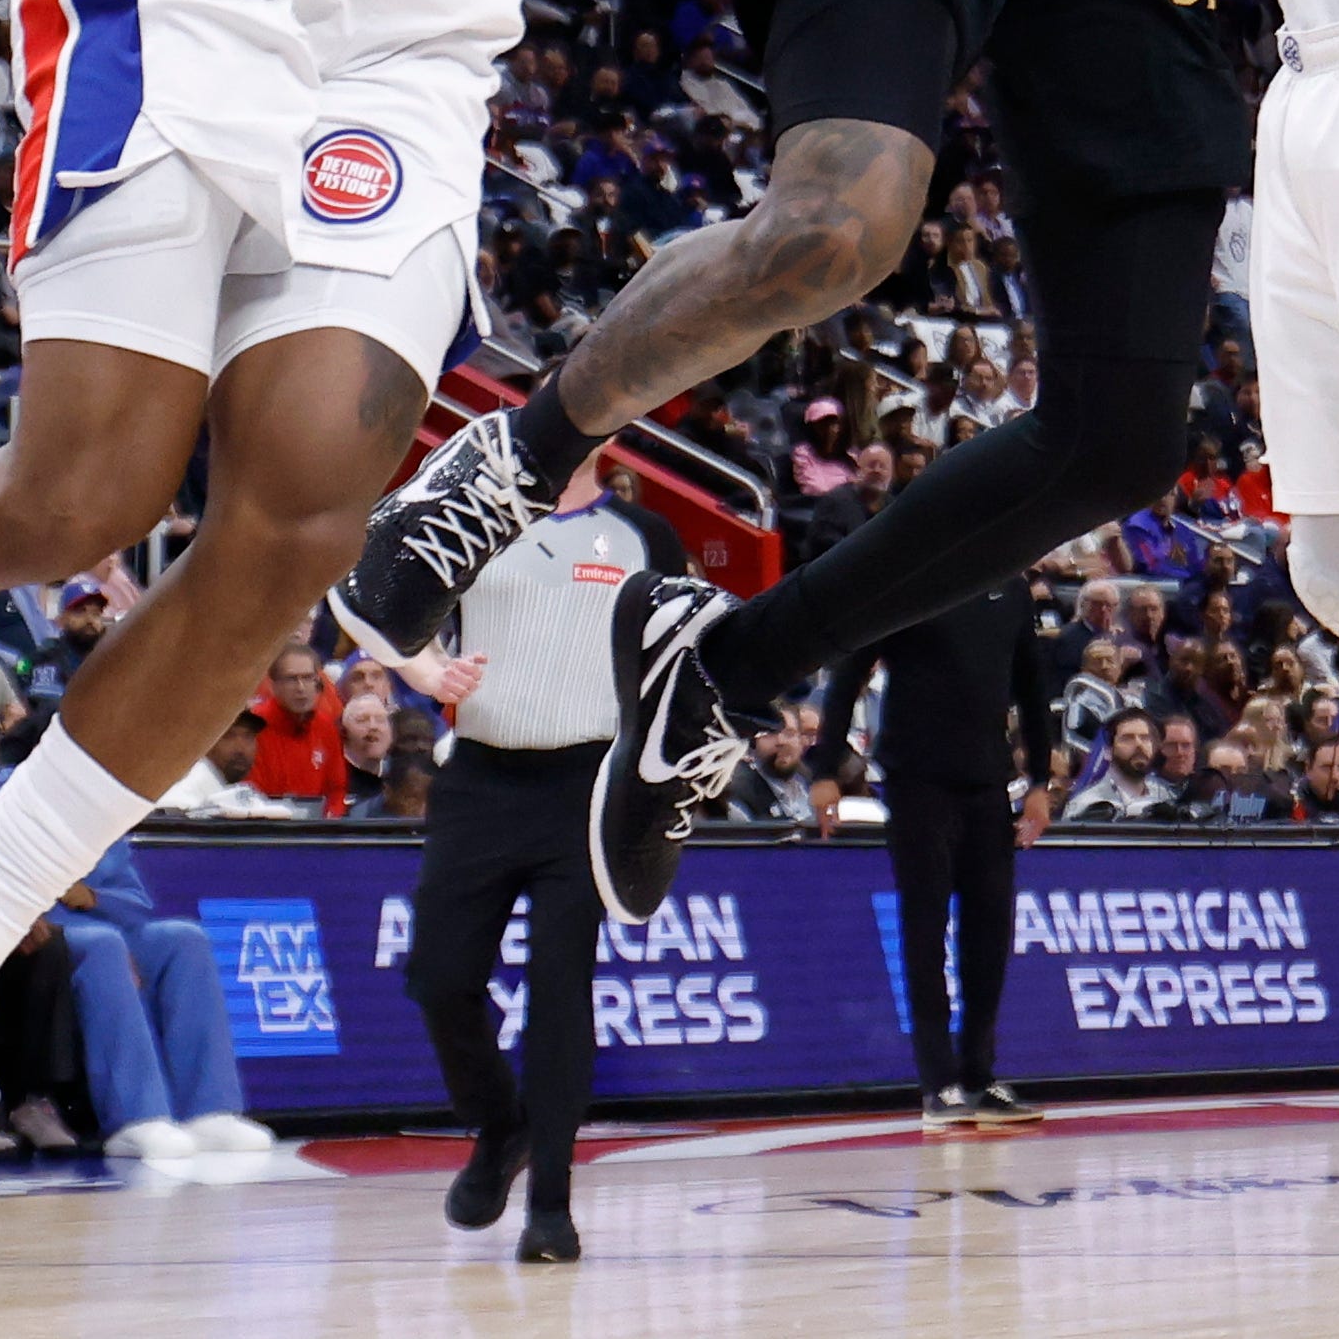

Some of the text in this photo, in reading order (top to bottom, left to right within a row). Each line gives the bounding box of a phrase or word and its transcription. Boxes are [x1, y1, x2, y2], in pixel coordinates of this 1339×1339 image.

[314, 171, 380, 200] PISTONS
[320, 155, 385, 183] DETROIT
[1013, 889, 1309, 954] AMERICAN
[1065, 961, 1329, 1030] EXPRESS
